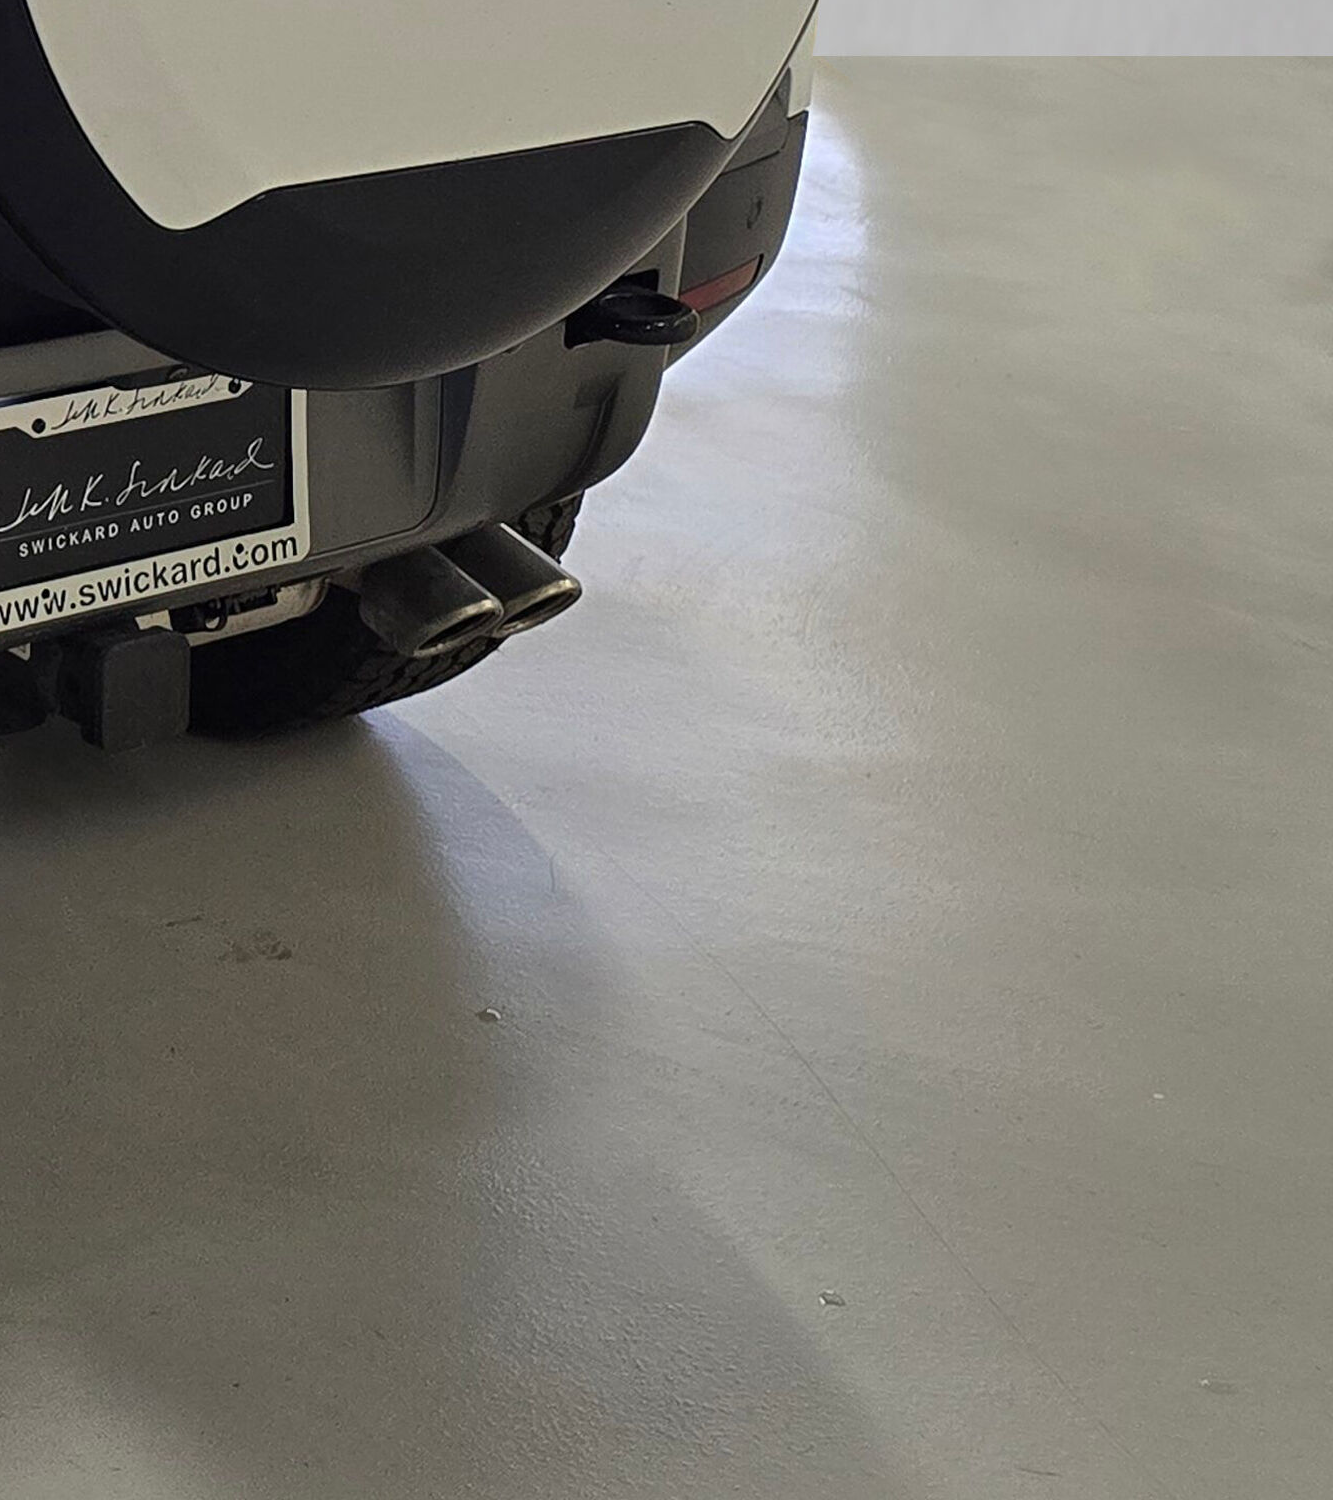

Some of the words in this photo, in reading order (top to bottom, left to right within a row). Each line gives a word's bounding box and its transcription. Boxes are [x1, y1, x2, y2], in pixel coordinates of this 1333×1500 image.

[18, 522, 120, 558] SWICKARD
[129, 509, 180, 534] AUTO
[189, 493, 254, 520] GROUP
